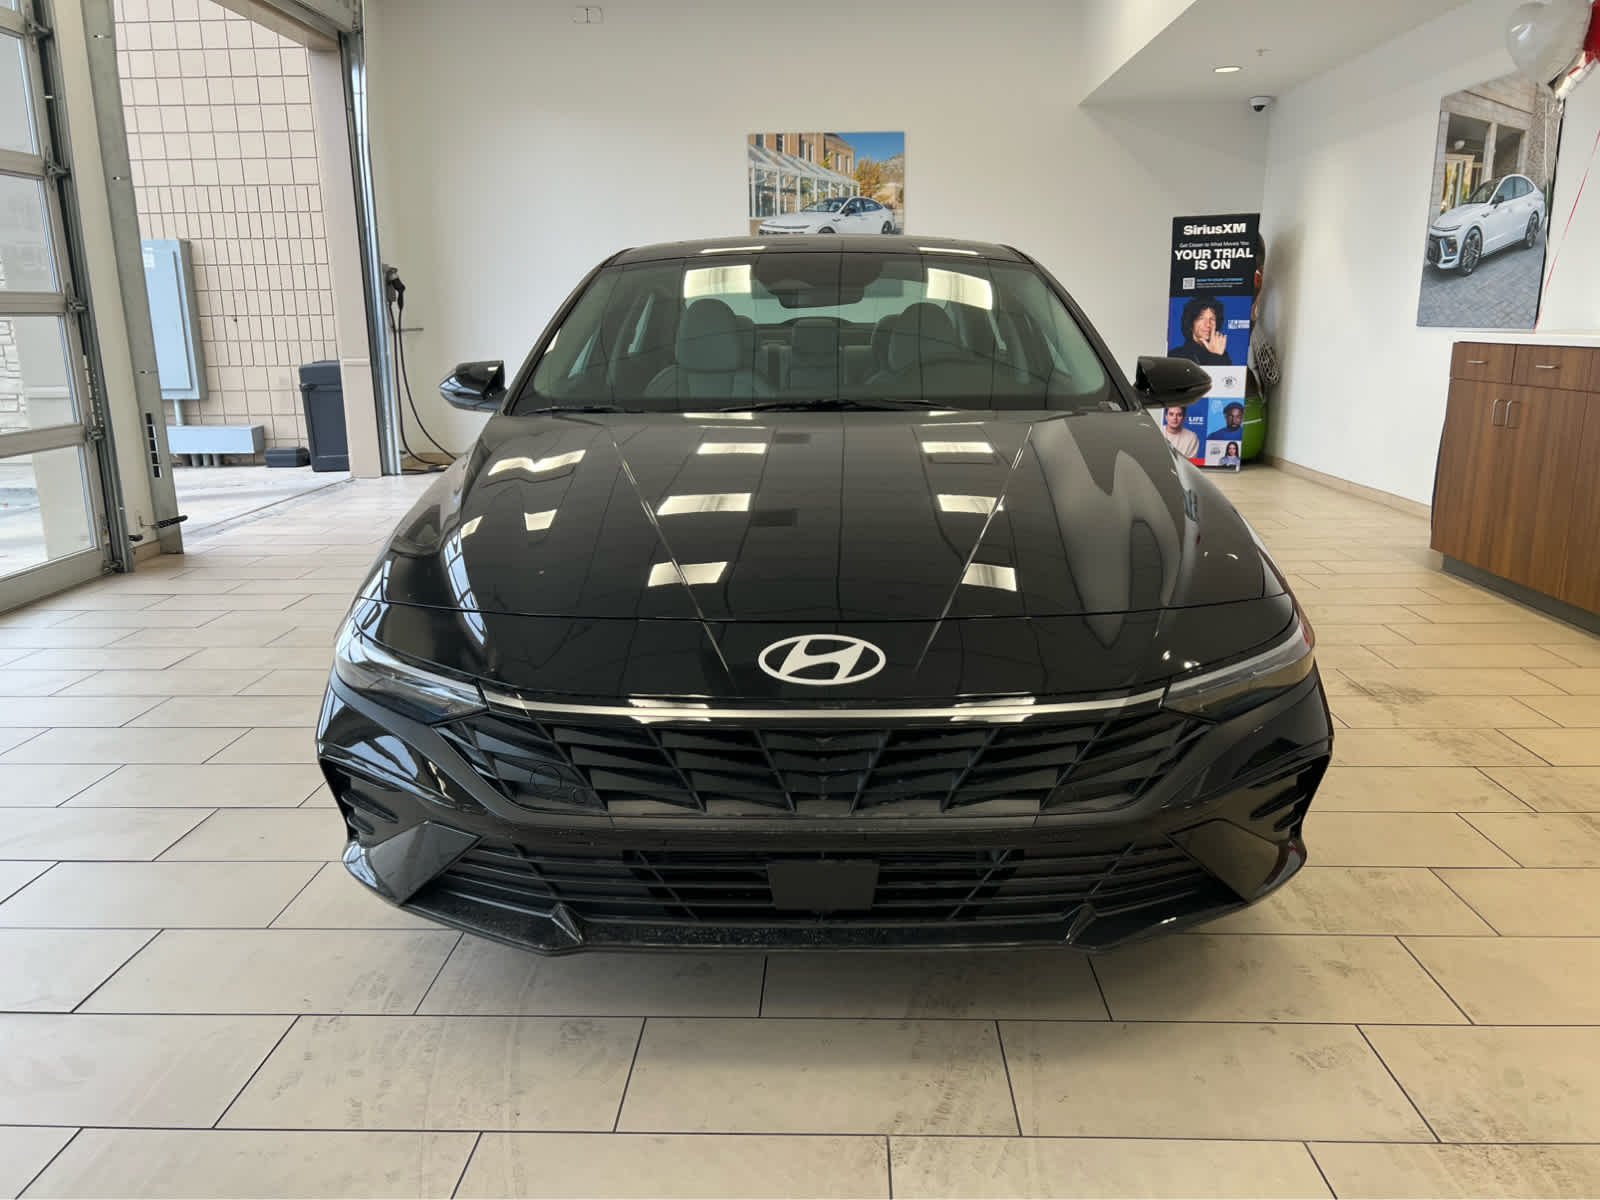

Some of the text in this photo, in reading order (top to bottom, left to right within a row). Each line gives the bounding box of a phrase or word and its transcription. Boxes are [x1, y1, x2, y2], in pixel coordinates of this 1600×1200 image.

[1183, 223, 1247, 236] SiriusXM
[1174, 247, 1254, 260] YOUR TRIAL
[1194, 259, 1231, 270] IS ON
